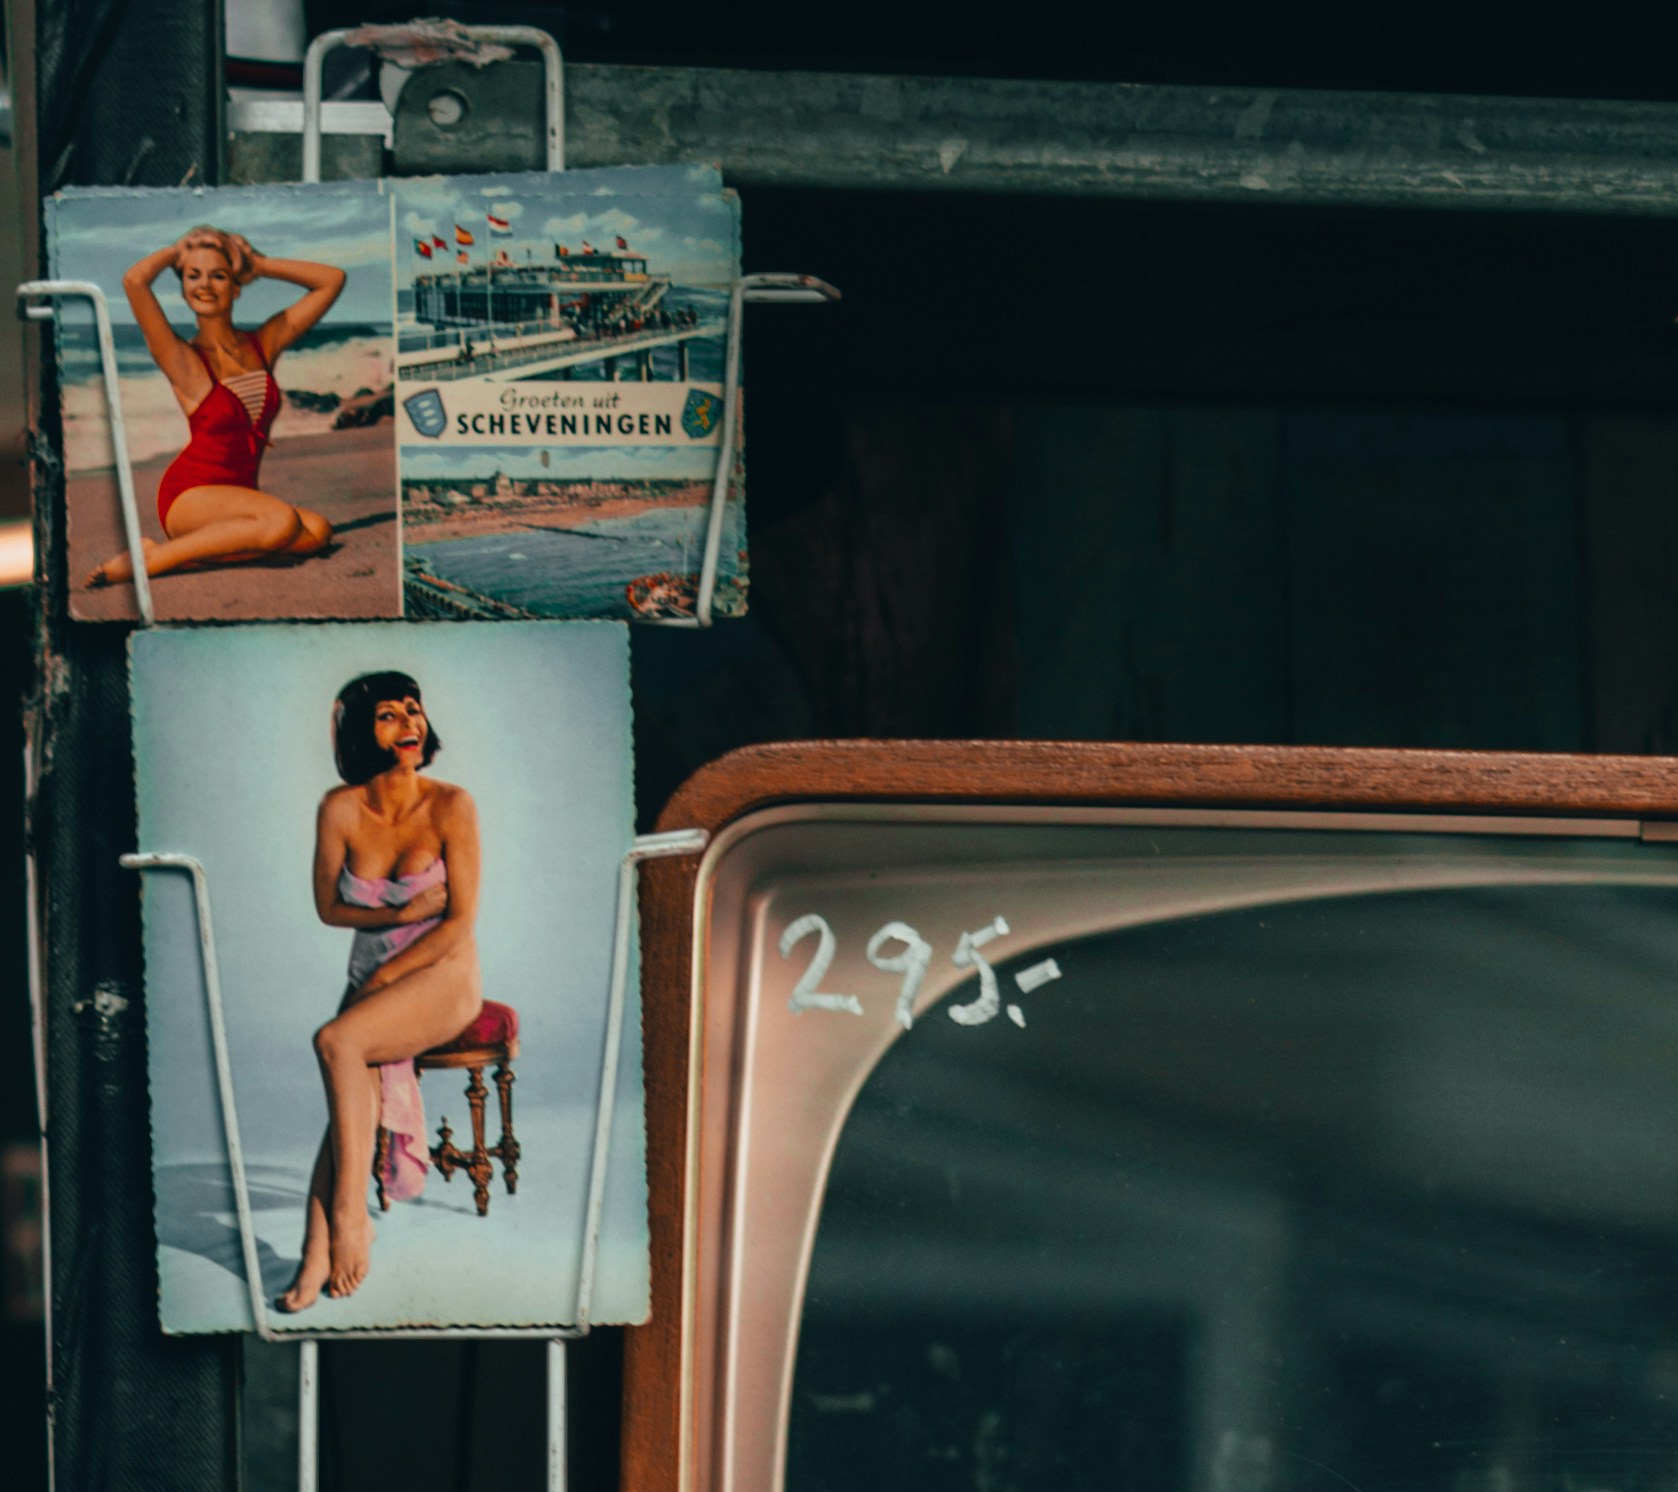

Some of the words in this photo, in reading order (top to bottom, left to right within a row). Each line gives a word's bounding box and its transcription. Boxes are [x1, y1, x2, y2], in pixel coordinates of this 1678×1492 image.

[499, 388, 585, 412] Groeten
[592, 392, 621, 409] uit
[457, 413, 672, 436] SCHEVENINGEN
